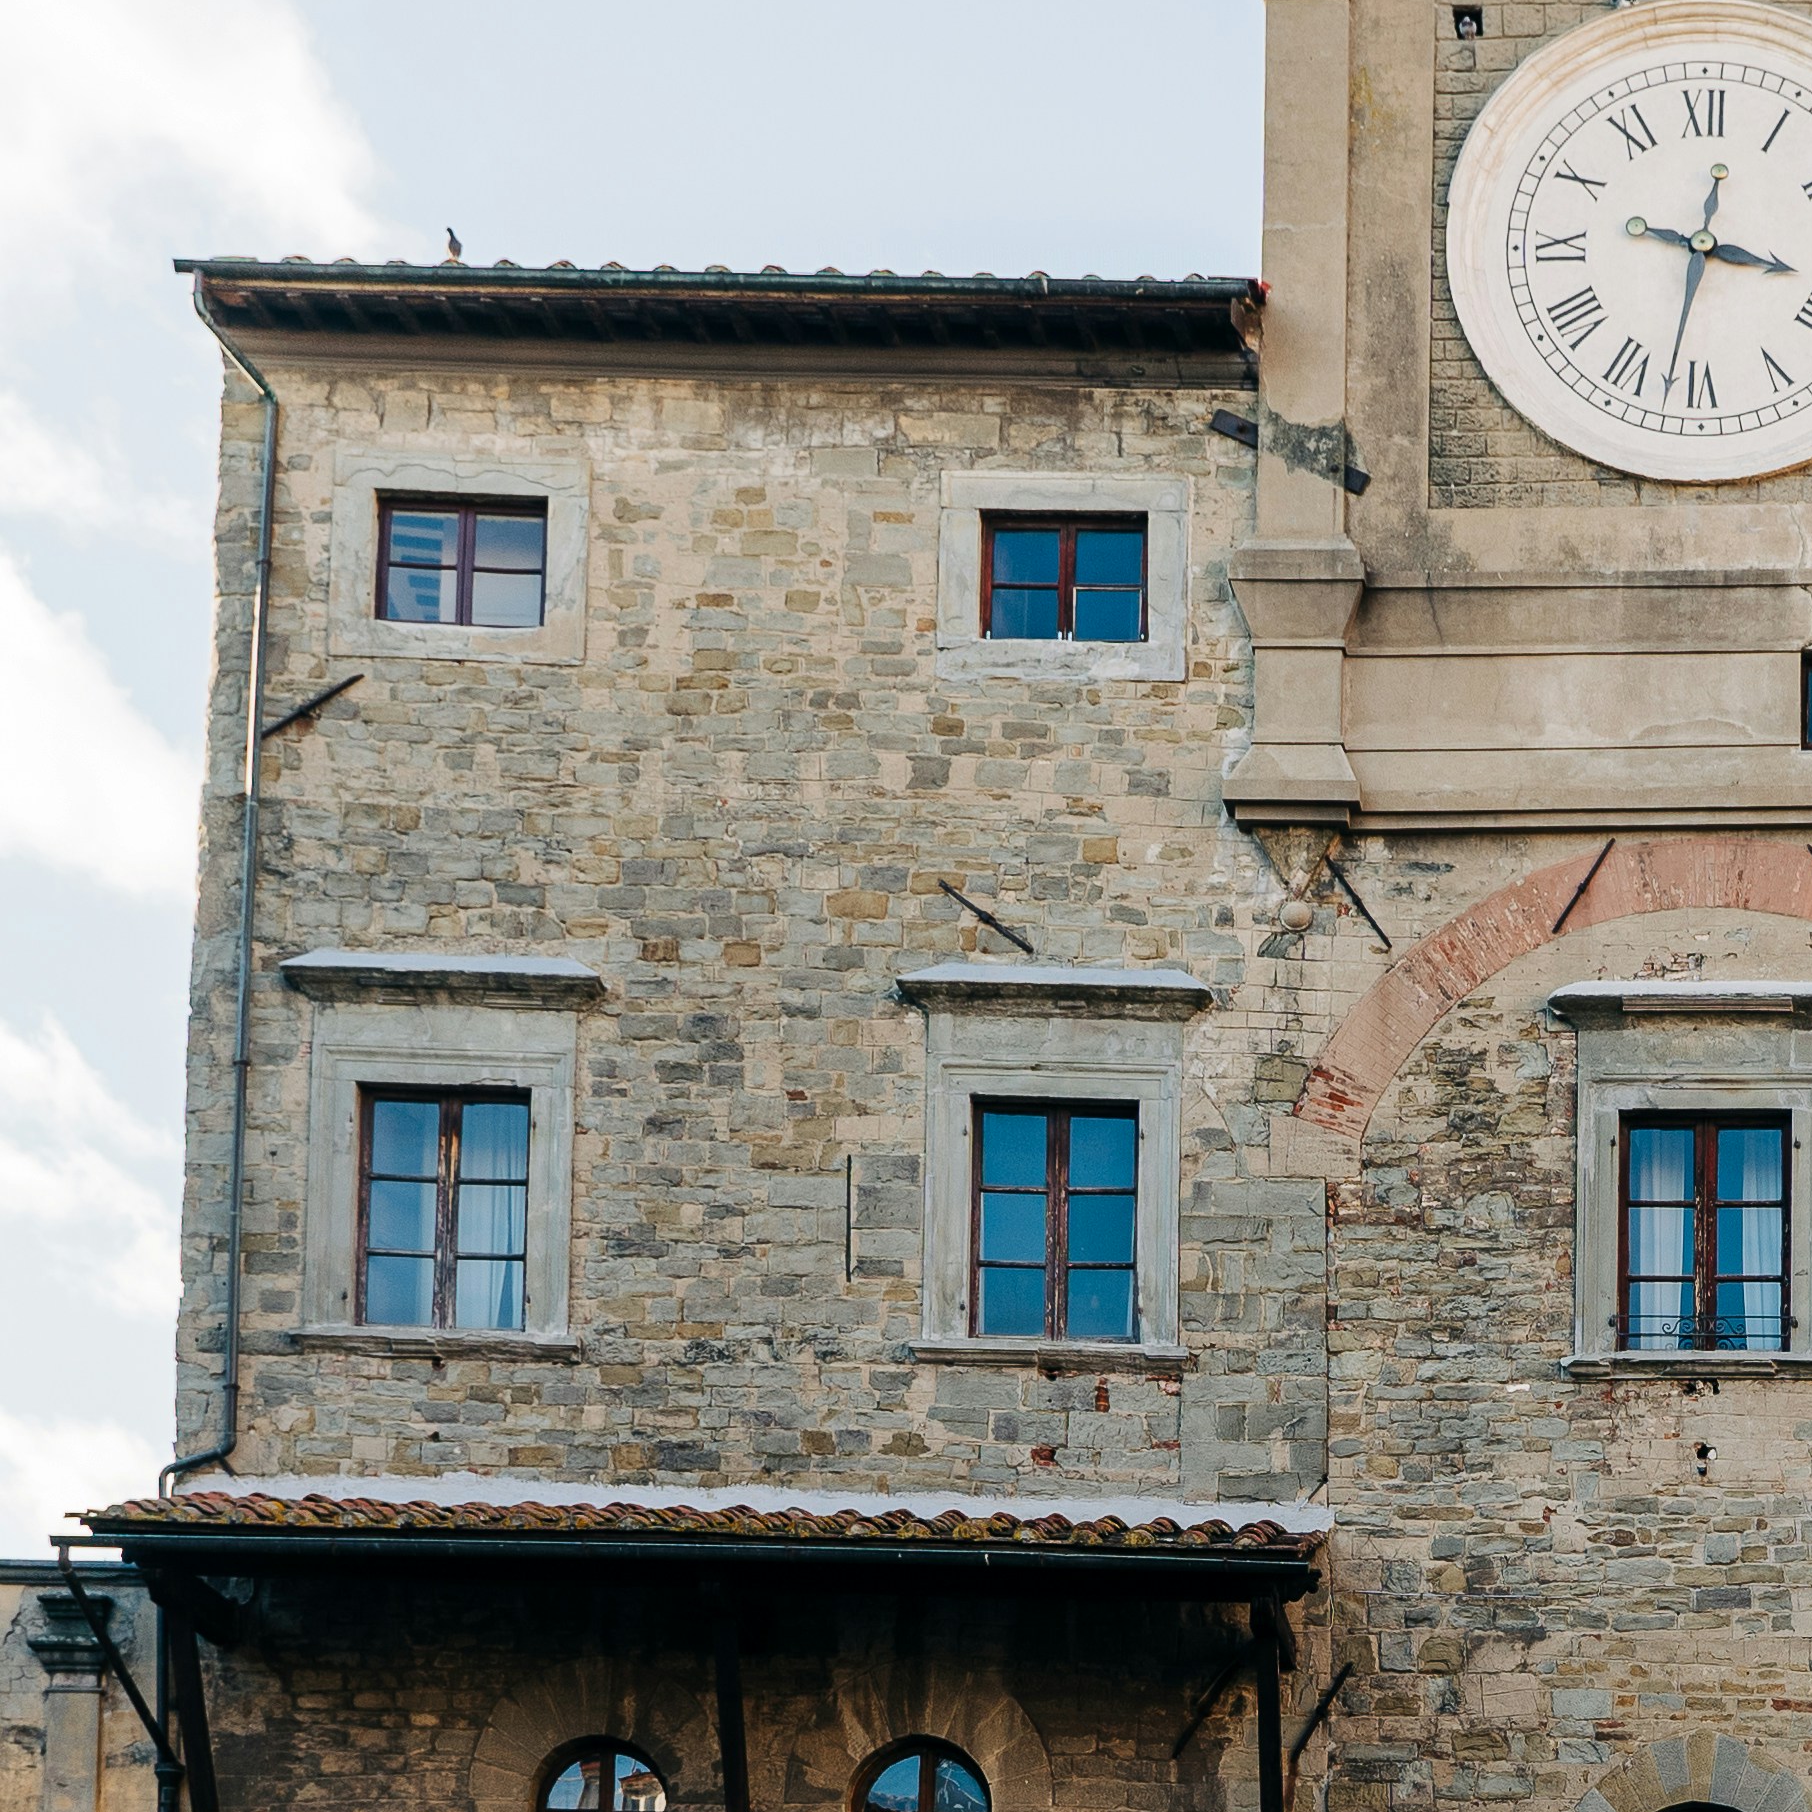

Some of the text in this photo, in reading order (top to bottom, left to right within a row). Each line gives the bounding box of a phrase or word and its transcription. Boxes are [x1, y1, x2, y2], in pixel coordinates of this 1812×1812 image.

[1607, 104, 1658, 160] XI
[1681, 90, 1725, 138] XII
[1762, 109, 1790, 152] I
[1555, 160, 1606, 201] X
[1535, 231, 1587, 262] IX
[1547, 286, 1608, 351] VIII
[1602, 337, 1651, 397] VII
[1686, 360, 1718, 409] VI
[1761, 346, 1795, 392] V
